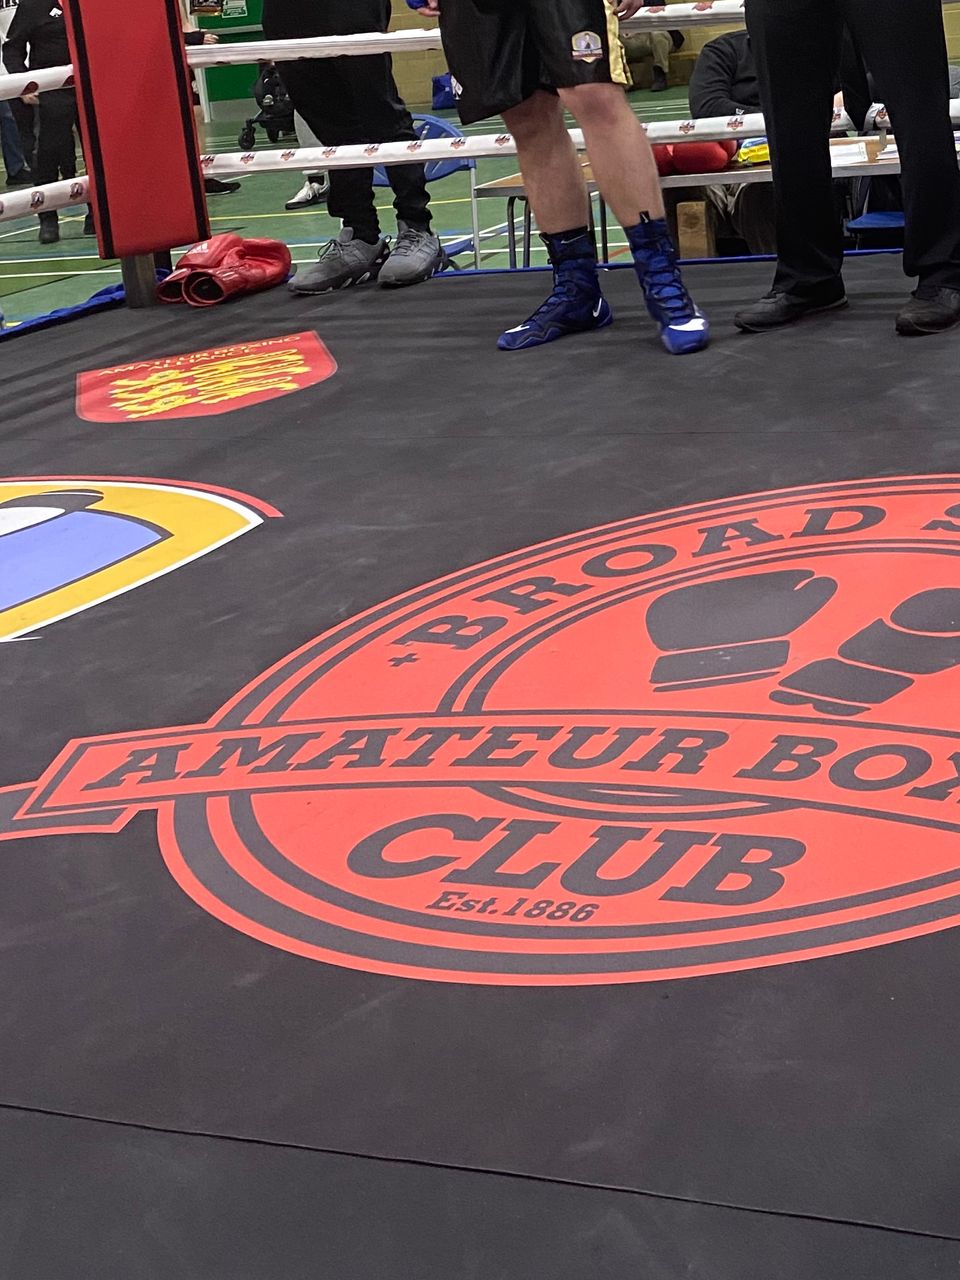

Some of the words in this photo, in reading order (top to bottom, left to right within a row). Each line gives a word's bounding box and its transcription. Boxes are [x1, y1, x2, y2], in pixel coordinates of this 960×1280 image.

[415, 505, 886, 652] BROAD
[82, 724, 716, 793] AMATEUR
[346, 812, 803, 906] CLUB
[424, 889, 601, 924] Est.1886
